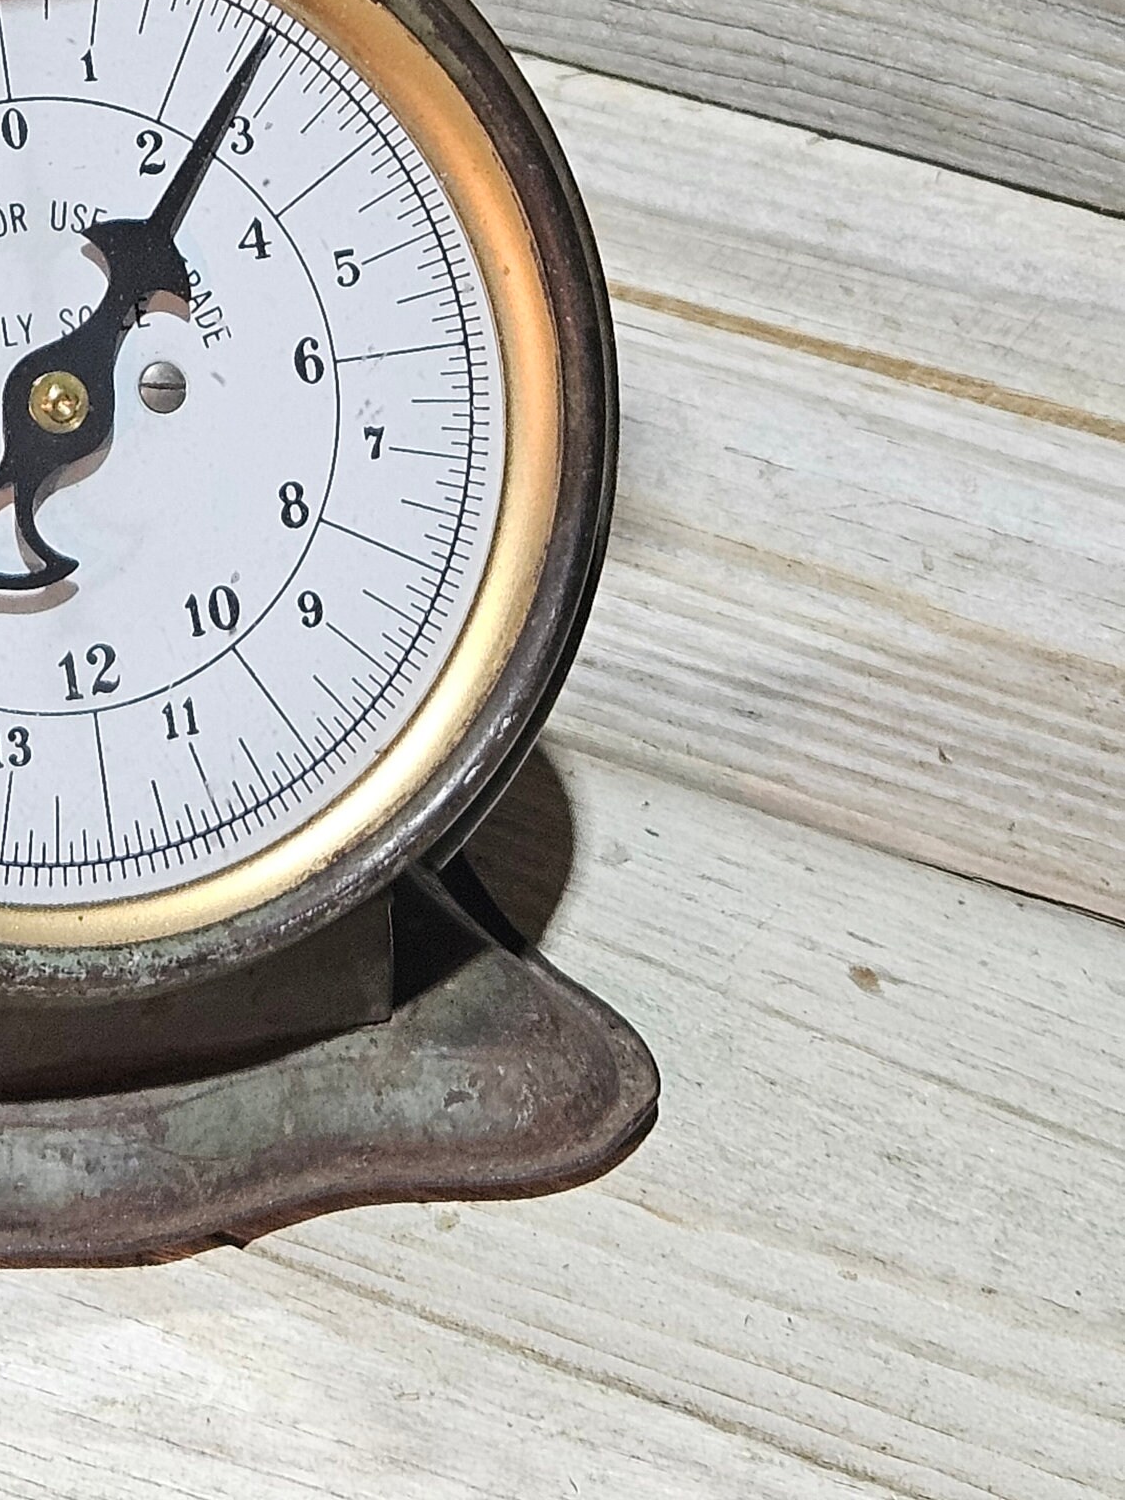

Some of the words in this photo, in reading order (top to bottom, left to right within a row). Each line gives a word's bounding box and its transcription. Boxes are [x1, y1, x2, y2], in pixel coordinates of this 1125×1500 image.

[80, 50, 98, 82] 1
[1, 108, 29, 150] 0
[227, 116, 254, 155] 3
[136, 129, 166, 177] 2
[238, 217, 272, 260] 4
[333, 248, 361, 288] 5
[293, 336, 325, 385] 6
[363, 425, 385, 460] 7
[278, 481, 310, 529] 8
[184, 585, 240, 637] 10
[297, 590, 324, 629] 9
[58, 643, 121, 701] 12
[161, 696, 200, 741] 11
